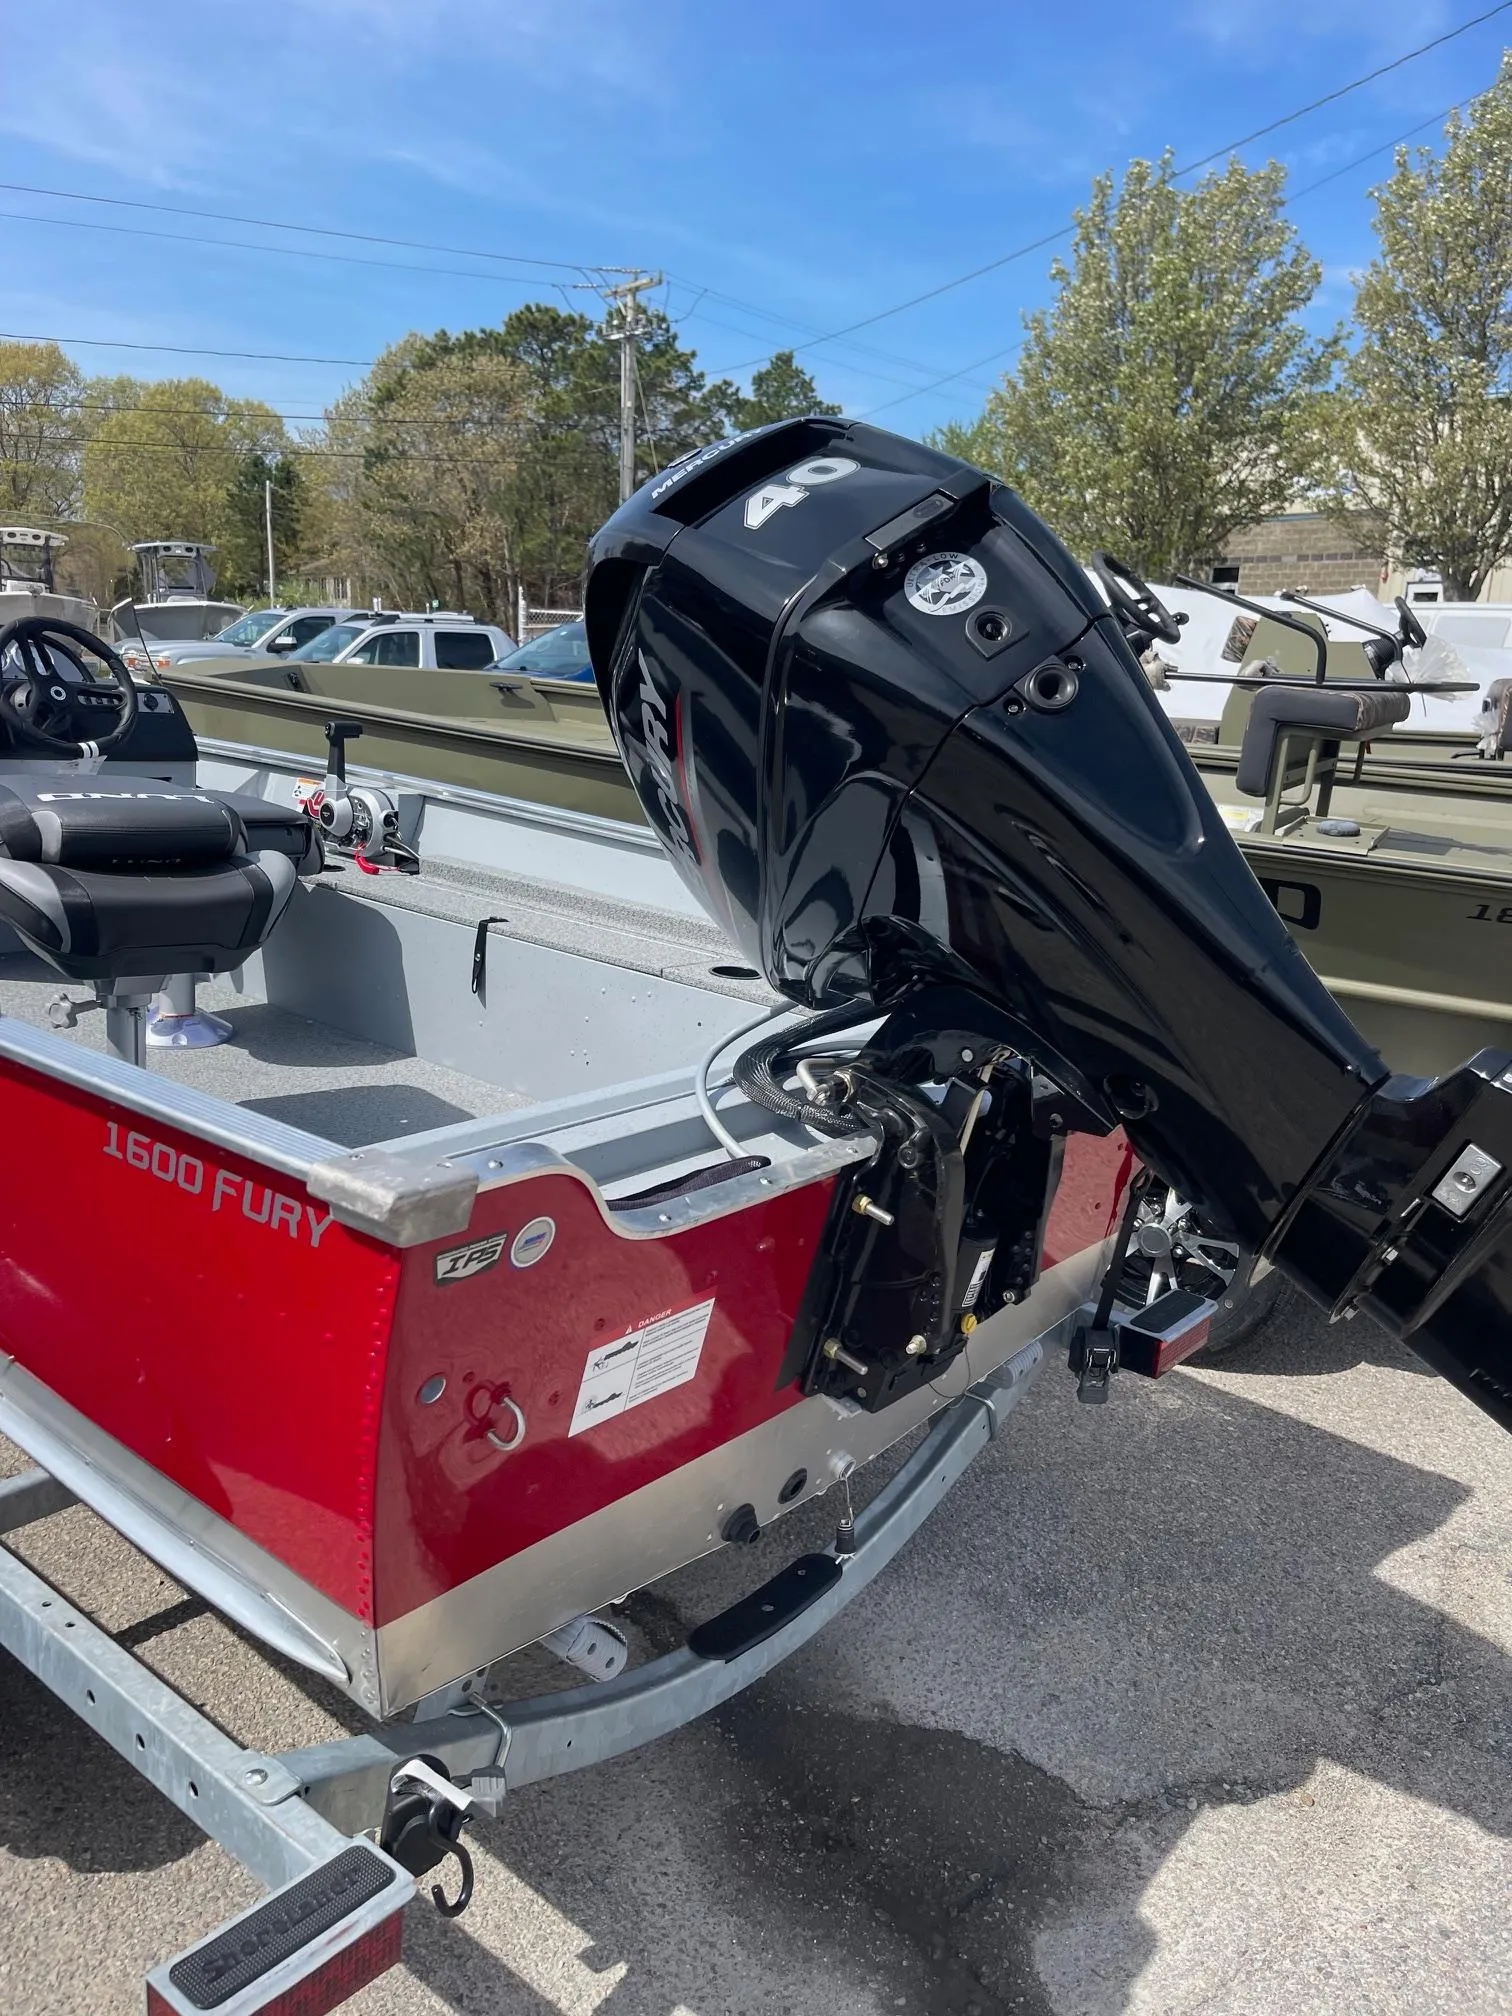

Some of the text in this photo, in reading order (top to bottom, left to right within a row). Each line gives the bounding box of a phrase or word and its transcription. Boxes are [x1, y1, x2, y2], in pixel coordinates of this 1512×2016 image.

[743, 457, 862, 530] 40
[103, 1121, 334, 1248] 1600 FURY
[441, 1242, 502, 1276] IPS
[637, 1308, 673, 1329] DANGER
